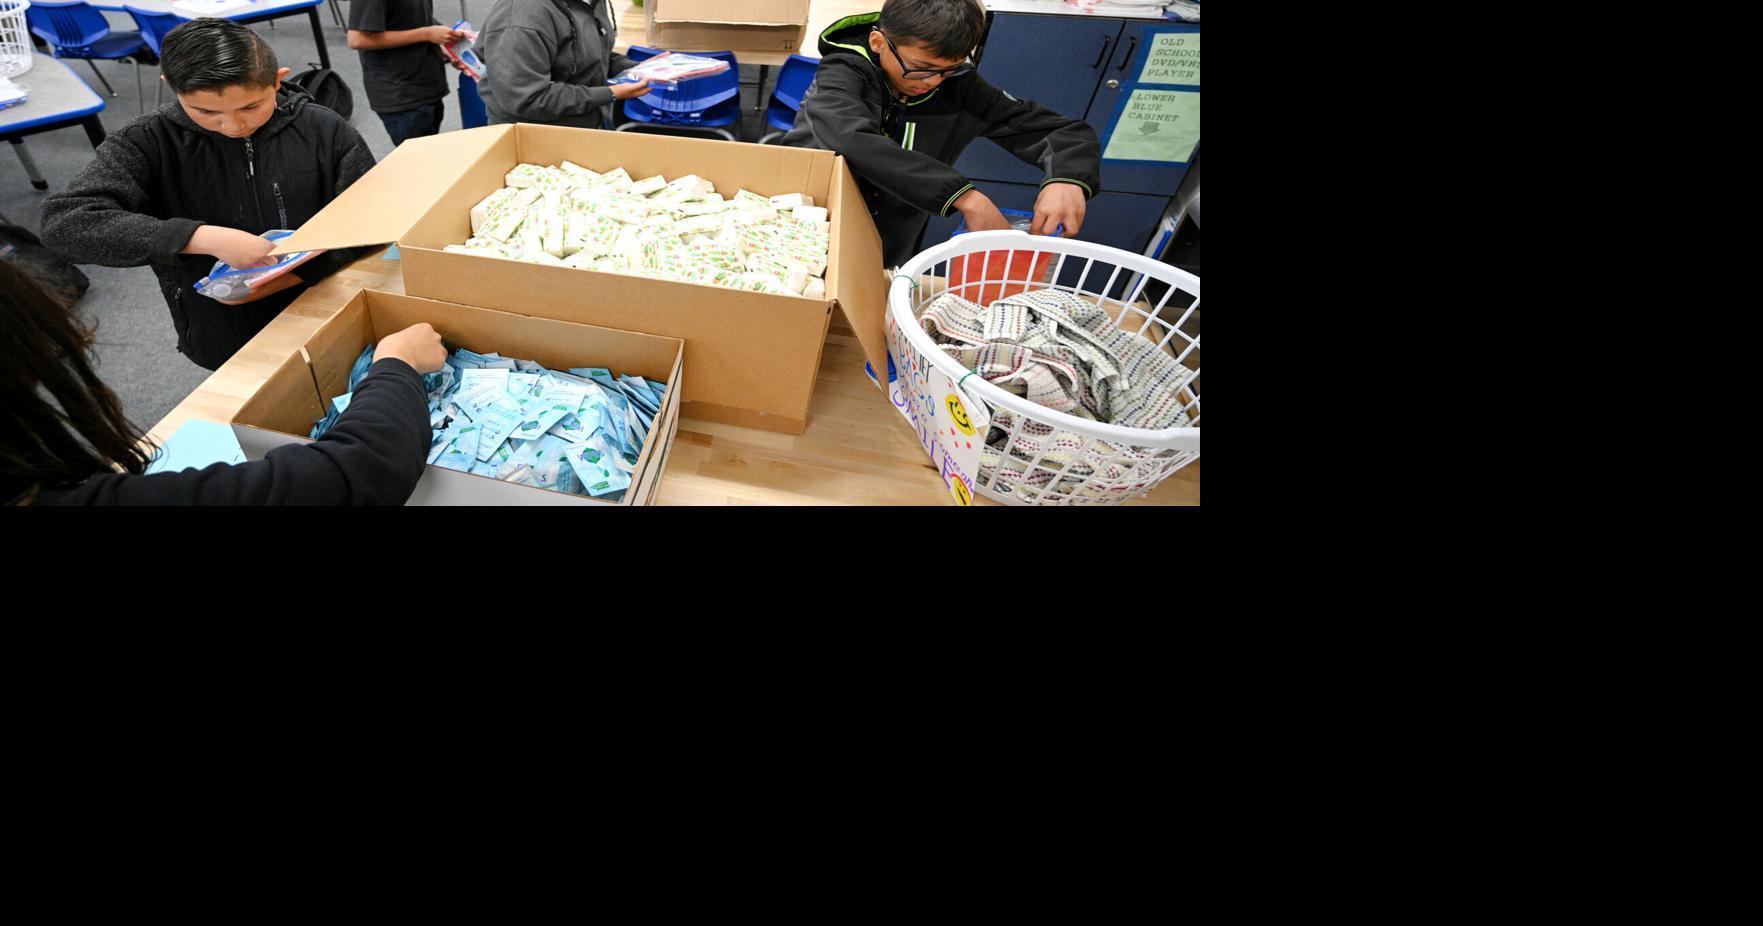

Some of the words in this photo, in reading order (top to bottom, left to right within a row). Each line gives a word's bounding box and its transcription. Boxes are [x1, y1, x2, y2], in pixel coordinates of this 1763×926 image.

[1160, 38, 1185, 46] OLD
[1147, 69, 1194, 78] PLAYER
[1136, 93, 1176, 102] LOWER
[1132, 103, 1163, 111] BLUE
[1128, 112, 1180, 122] CABINET
